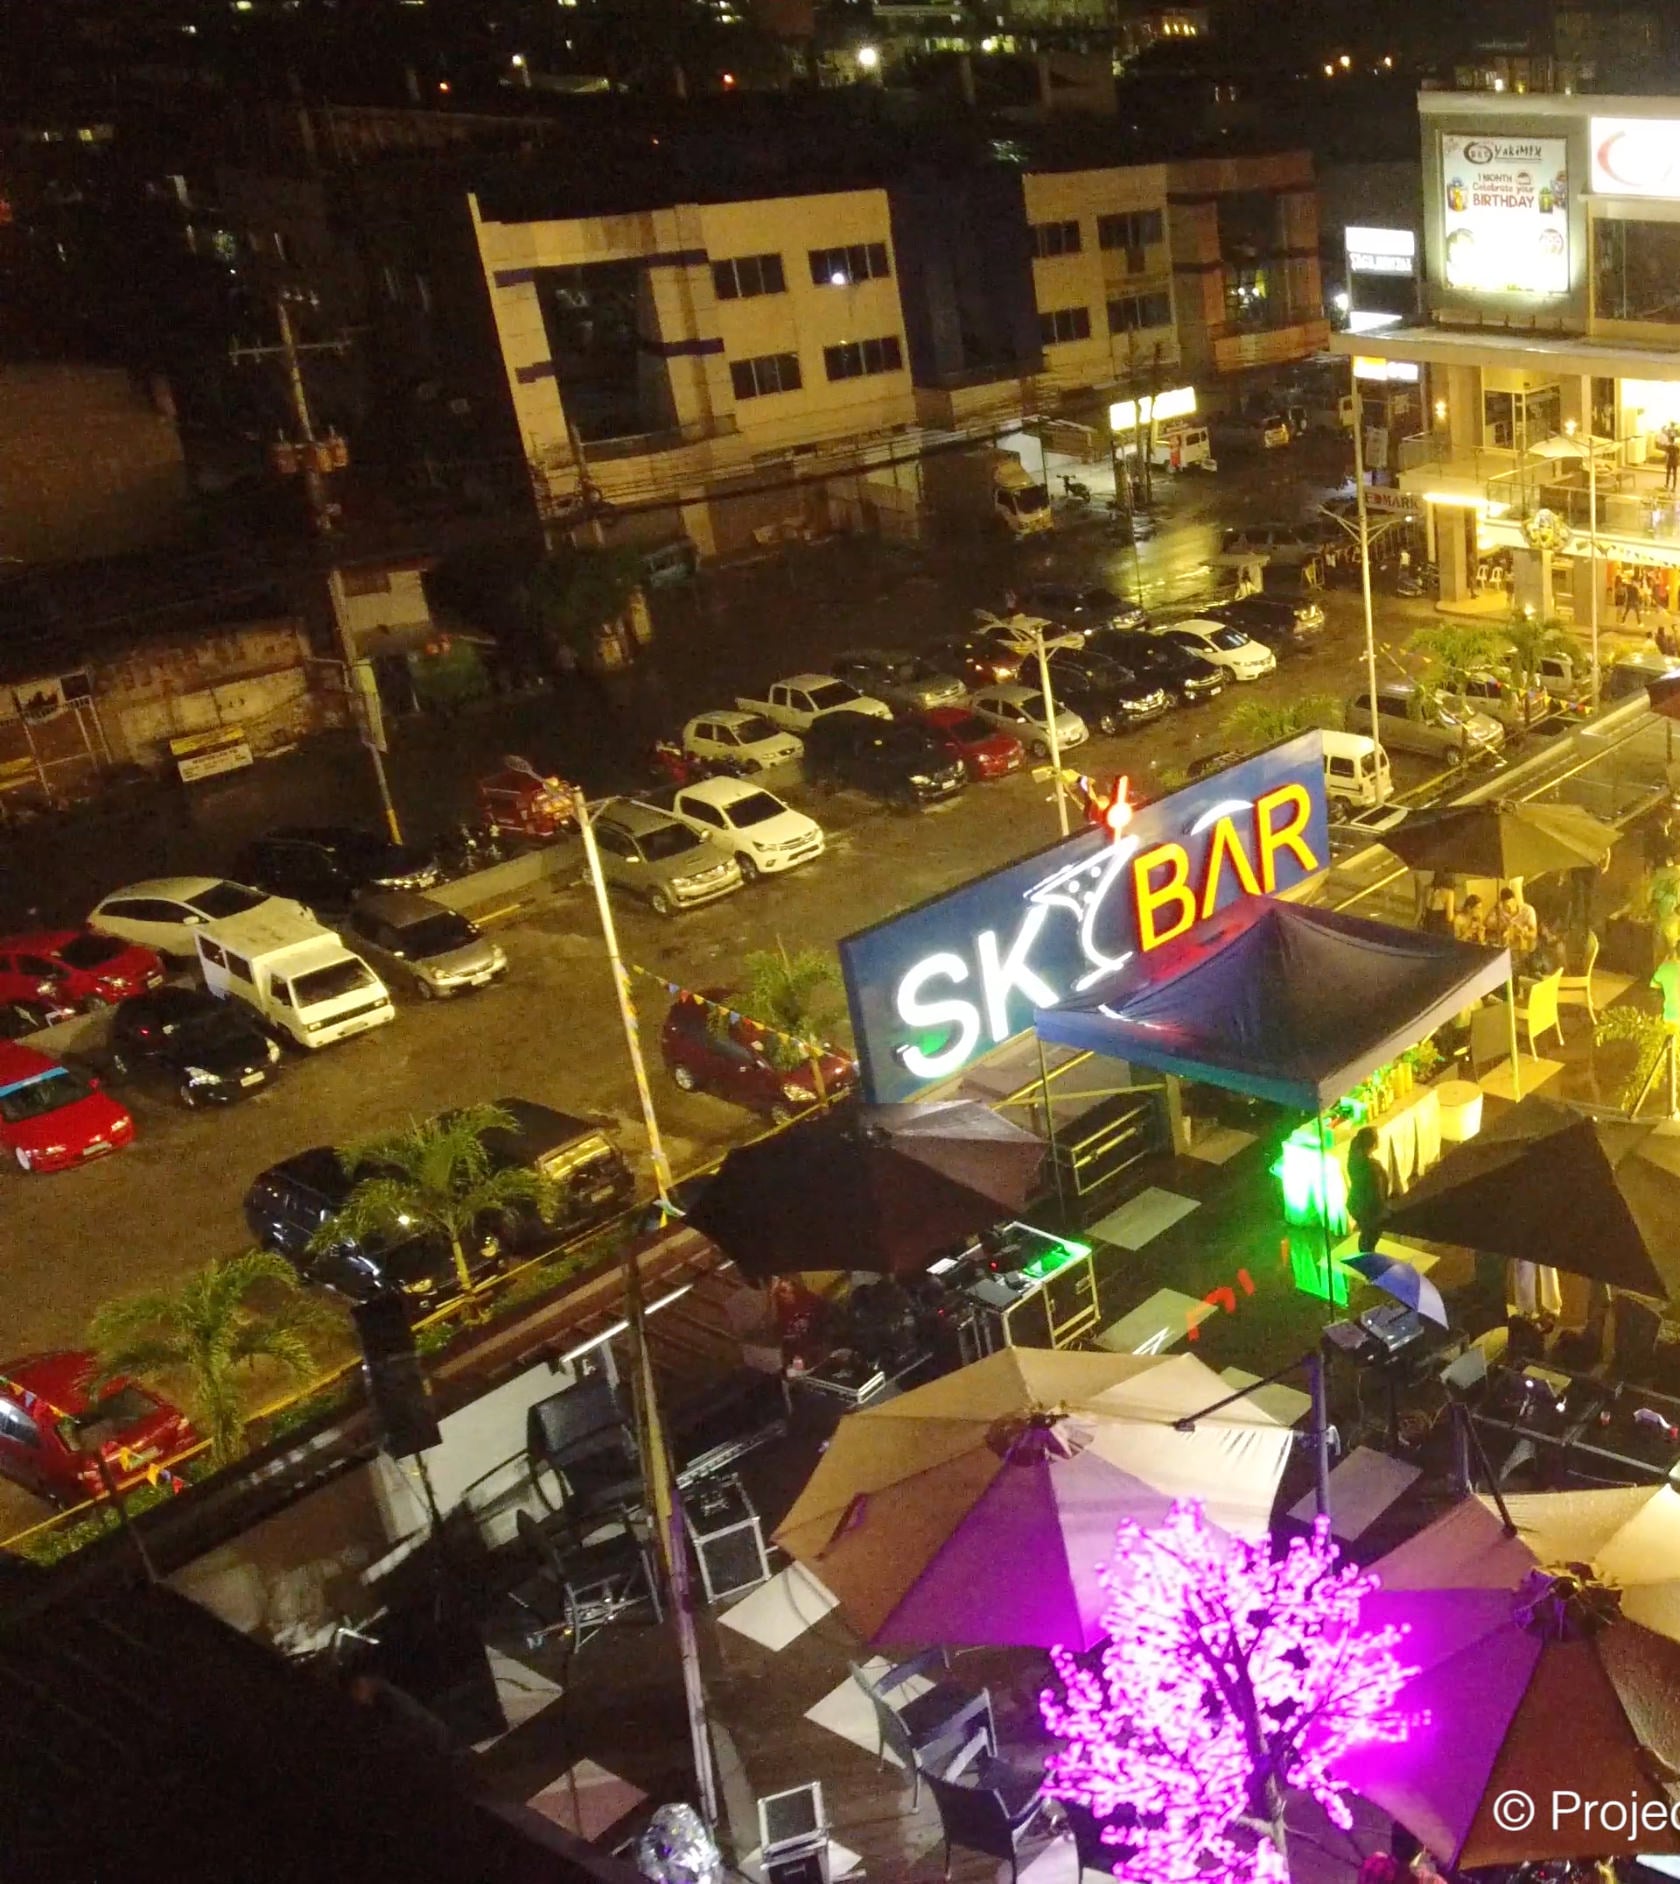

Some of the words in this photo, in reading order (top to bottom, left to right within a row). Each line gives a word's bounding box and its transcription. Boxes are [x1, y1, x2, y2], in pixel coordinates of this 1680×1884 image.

[1483, 173, 1512, 183] MONTH
[1472, 182, 1513, 192] Celebrate
[1516, 184, 1535, 195] your
[1472, 193, 1535, 208] BIRTHDAY
[1130, 783, 1320, 953] BAR
